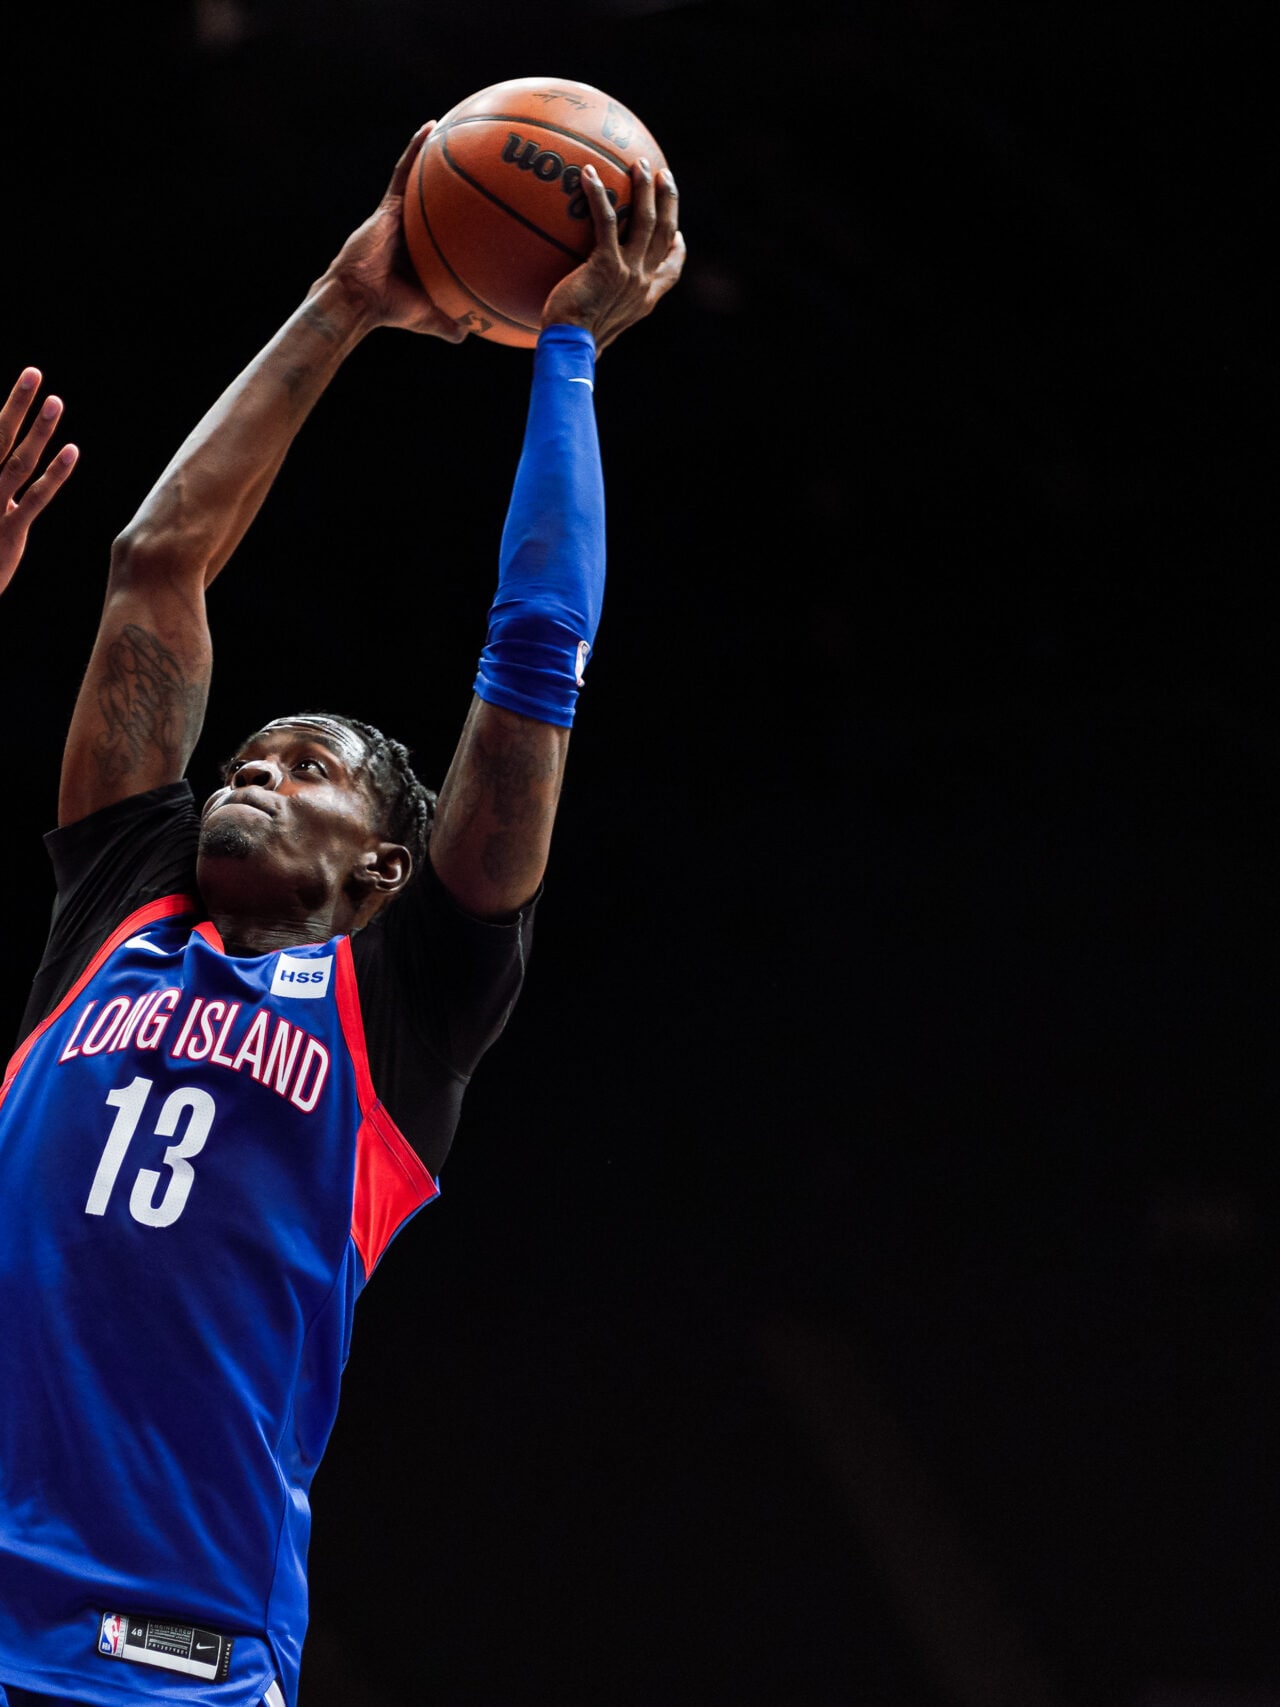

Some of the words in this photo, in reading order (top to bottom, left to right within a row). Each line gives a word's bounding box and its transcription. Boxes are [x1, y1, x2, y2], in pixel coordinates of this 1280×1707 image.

[280, 969, 324, 984] HSS
[59, 988, 182, 1064] LONG
[172, 997, 331, 1115] ISLAND
[84, 1075, 216, 1228] 13
[131, 1626, 143, 1638] 48
